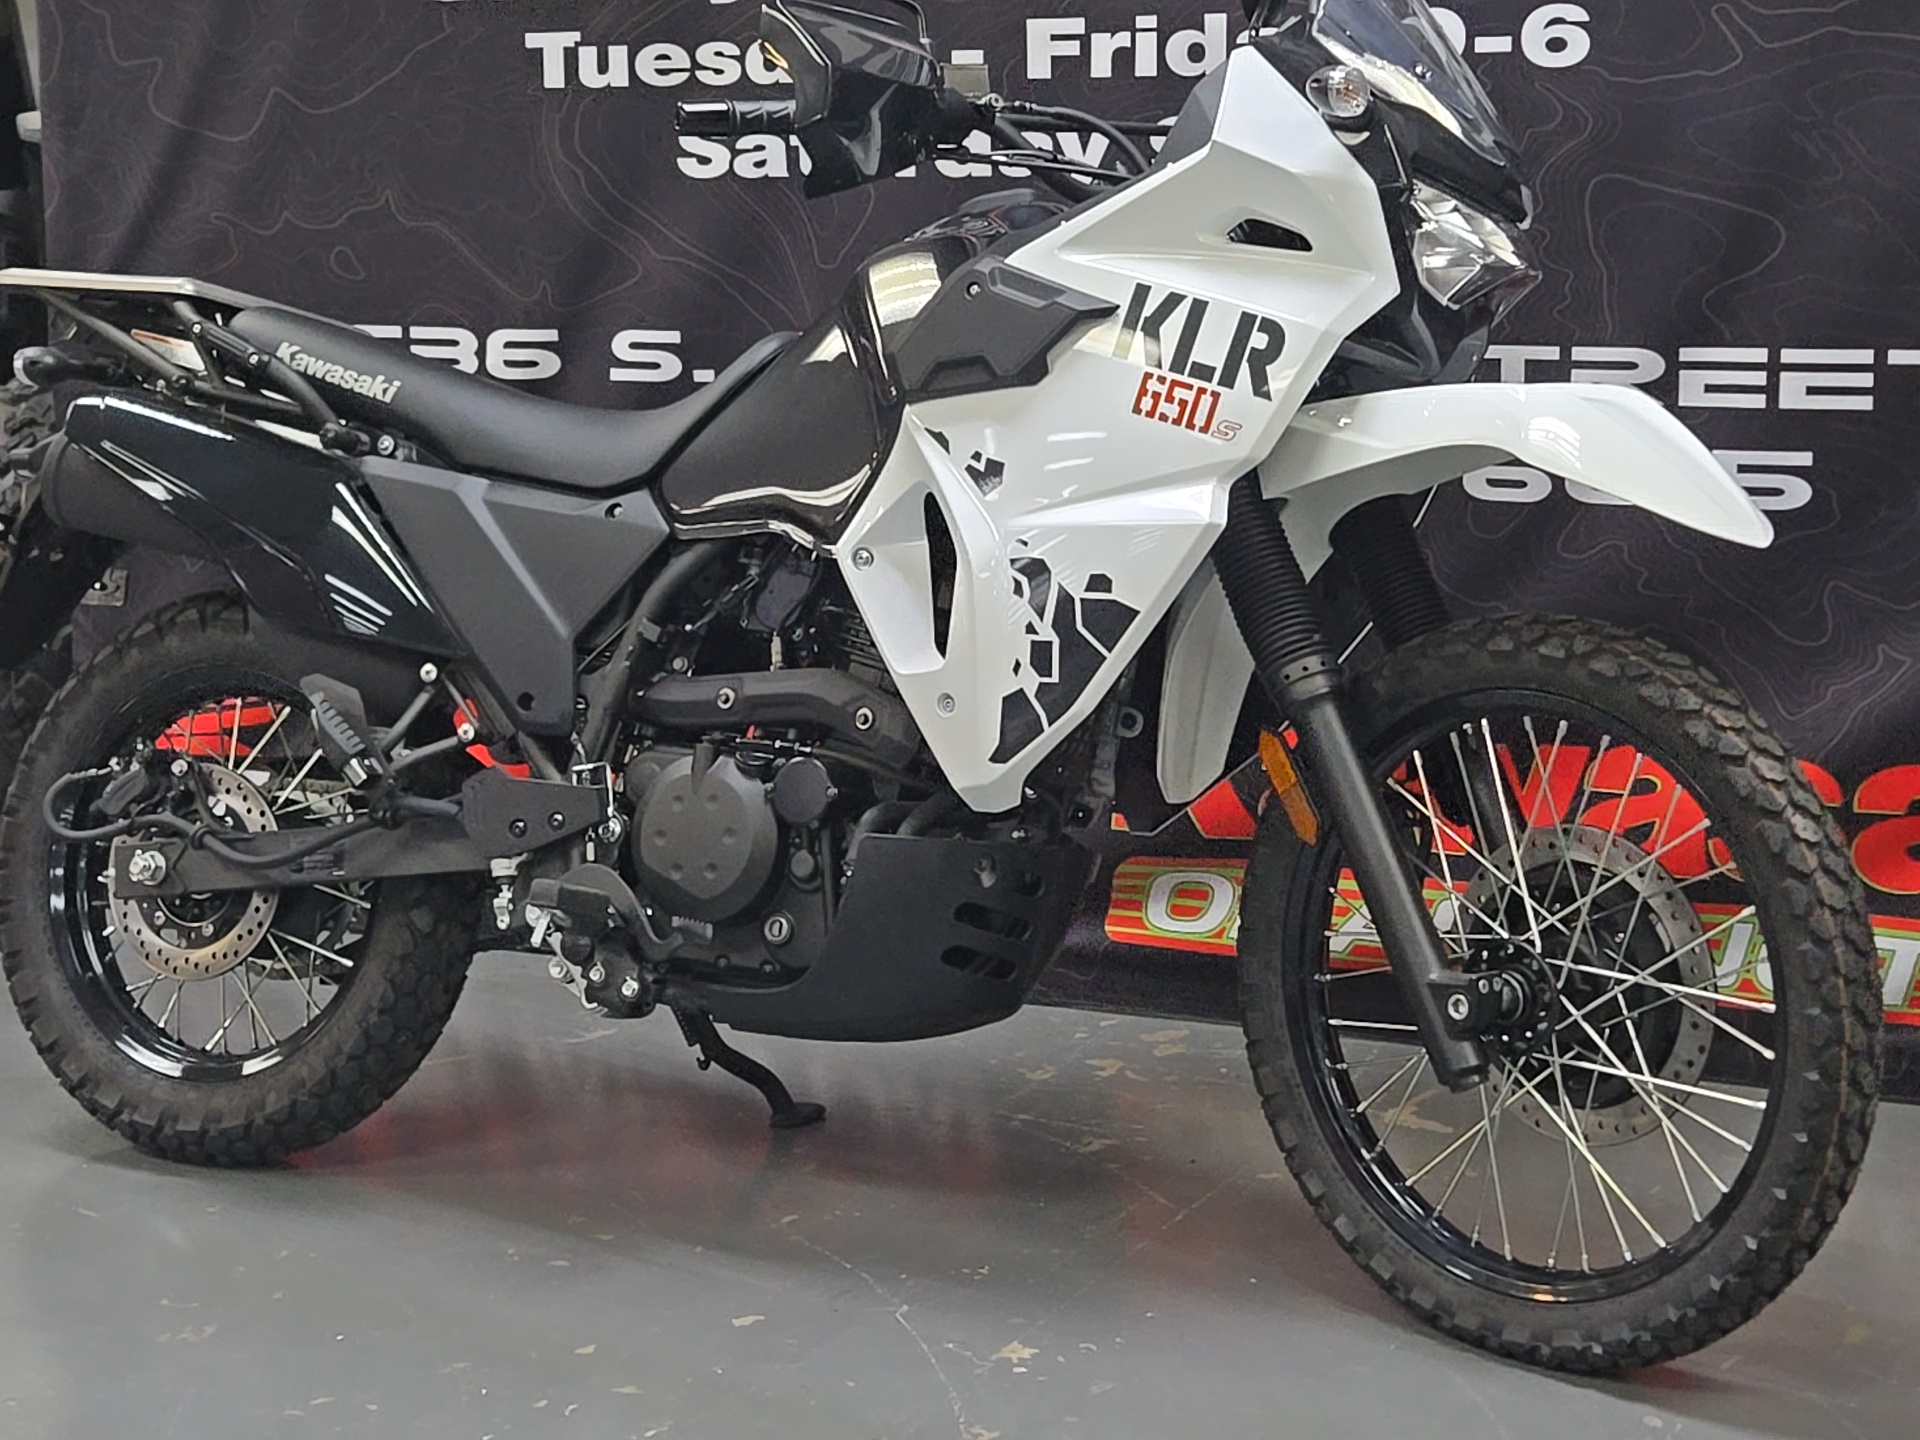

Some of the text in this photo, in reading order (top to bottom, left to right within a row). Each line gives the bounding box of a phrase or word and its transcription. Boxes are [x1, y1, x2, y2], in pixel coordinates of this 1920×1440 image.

[1026, 13, 1279, 79] Frid
[275, 341, 402, 404] Kawasaki
[610, 330, 715, 382] S.
[1112, 282, 1286, 402] KLR
